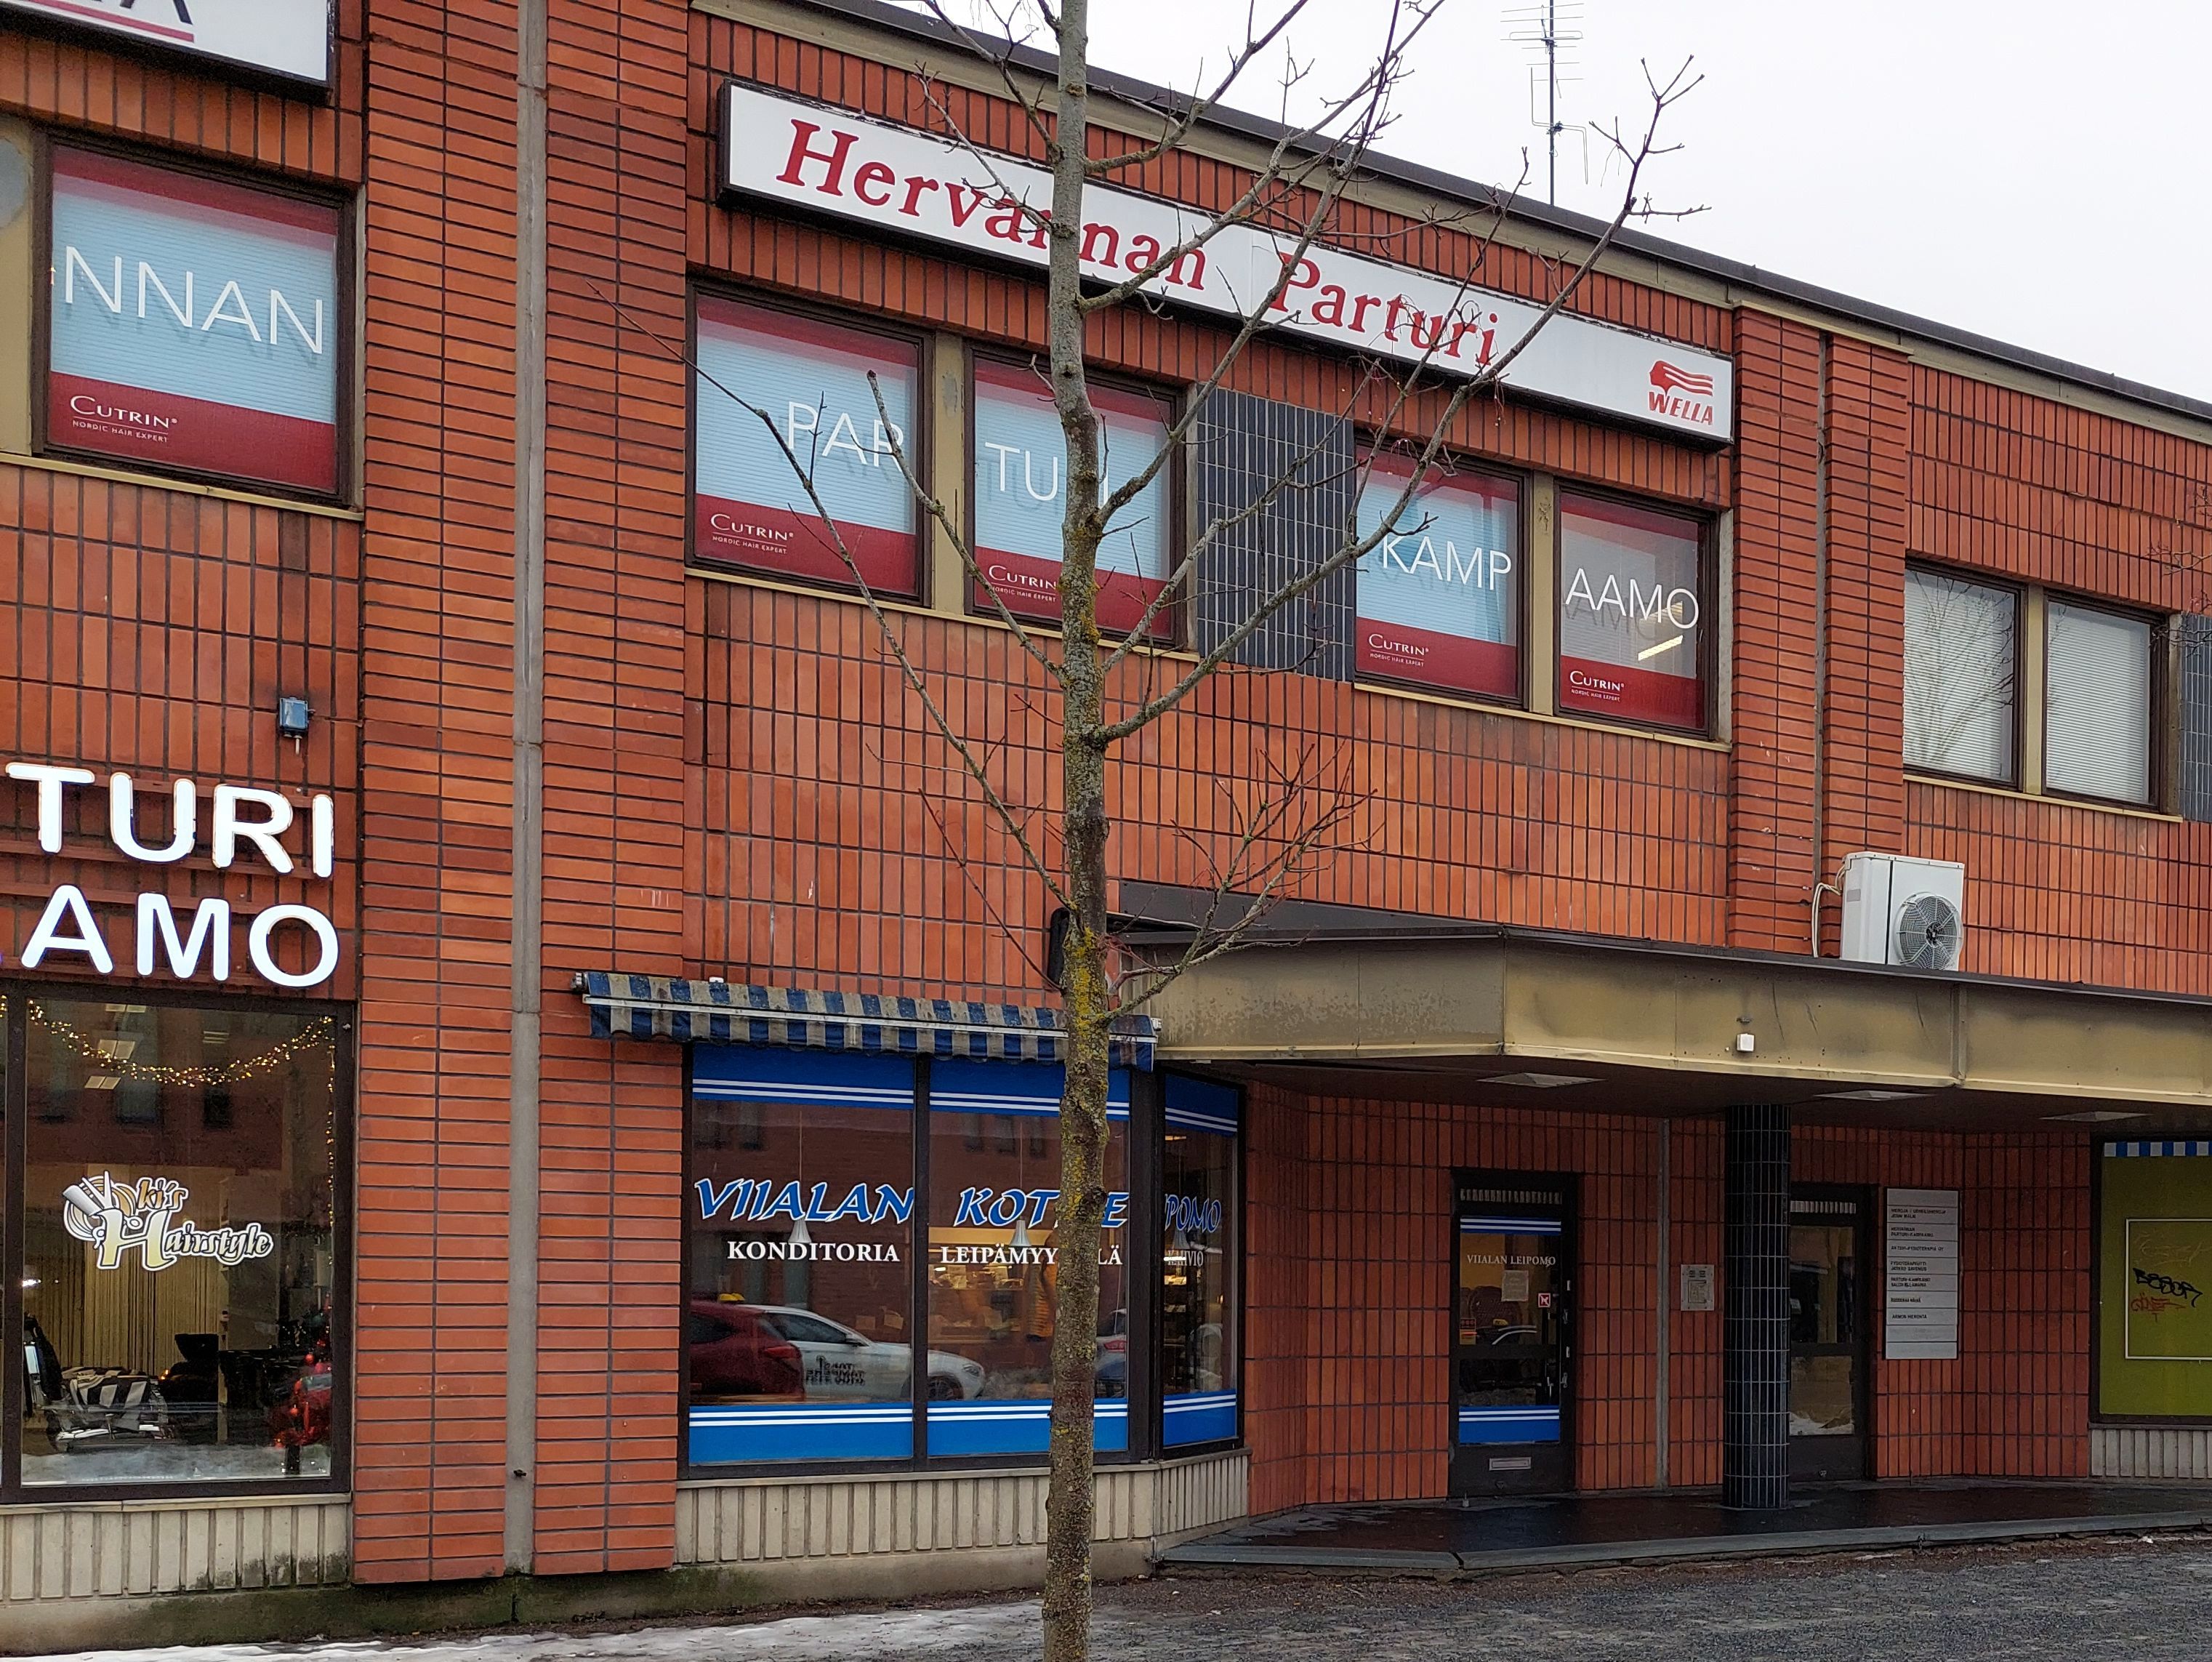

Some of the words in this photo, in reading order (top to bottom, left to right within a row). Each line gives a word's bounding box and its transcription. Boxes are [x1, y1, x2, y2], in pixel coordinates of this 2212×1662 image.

[64, 246, 323, 355] NNAN
[1268, 252, 1497, 365] Parturi
[73, 419, 109, 432] NORDIC
[111, 427, 133, 437] HAIR
[136, 432, 168, 443] EXPERT
[1648, 391, 1713, 425] WELLA
[788, 401, 904, 473] PAR
[985, 442, 1109, 507] TUI
[712, 536, 741, 546] NORDIC
[742, 541, 760, 550] HAIR
[761, 545, 787, 555] EXPERT
[1381, 534, 1513, 590] KAMP
[1033, 593, 1057, 603] EXPERT
[1564, 568, 1700, 630] AAMO
[5, 762, 334, 878] TURI
[20, 884, 339, 987] AMO
[694, 1178, 914, 1224] VIIALAN
[953, 1187, 1130, 1229] KOTE
[97, 1208, 274, 1270] Hairstyle
[728, 1241, 901, 1262] KONDITORIA
[941, 1243, 1123, 1265] LEIPÄMYYLÄ
[1467, 1254, 1508, 1264] VIIALAN
[1511, 1255, 1556, 1266] LEIPOMO
